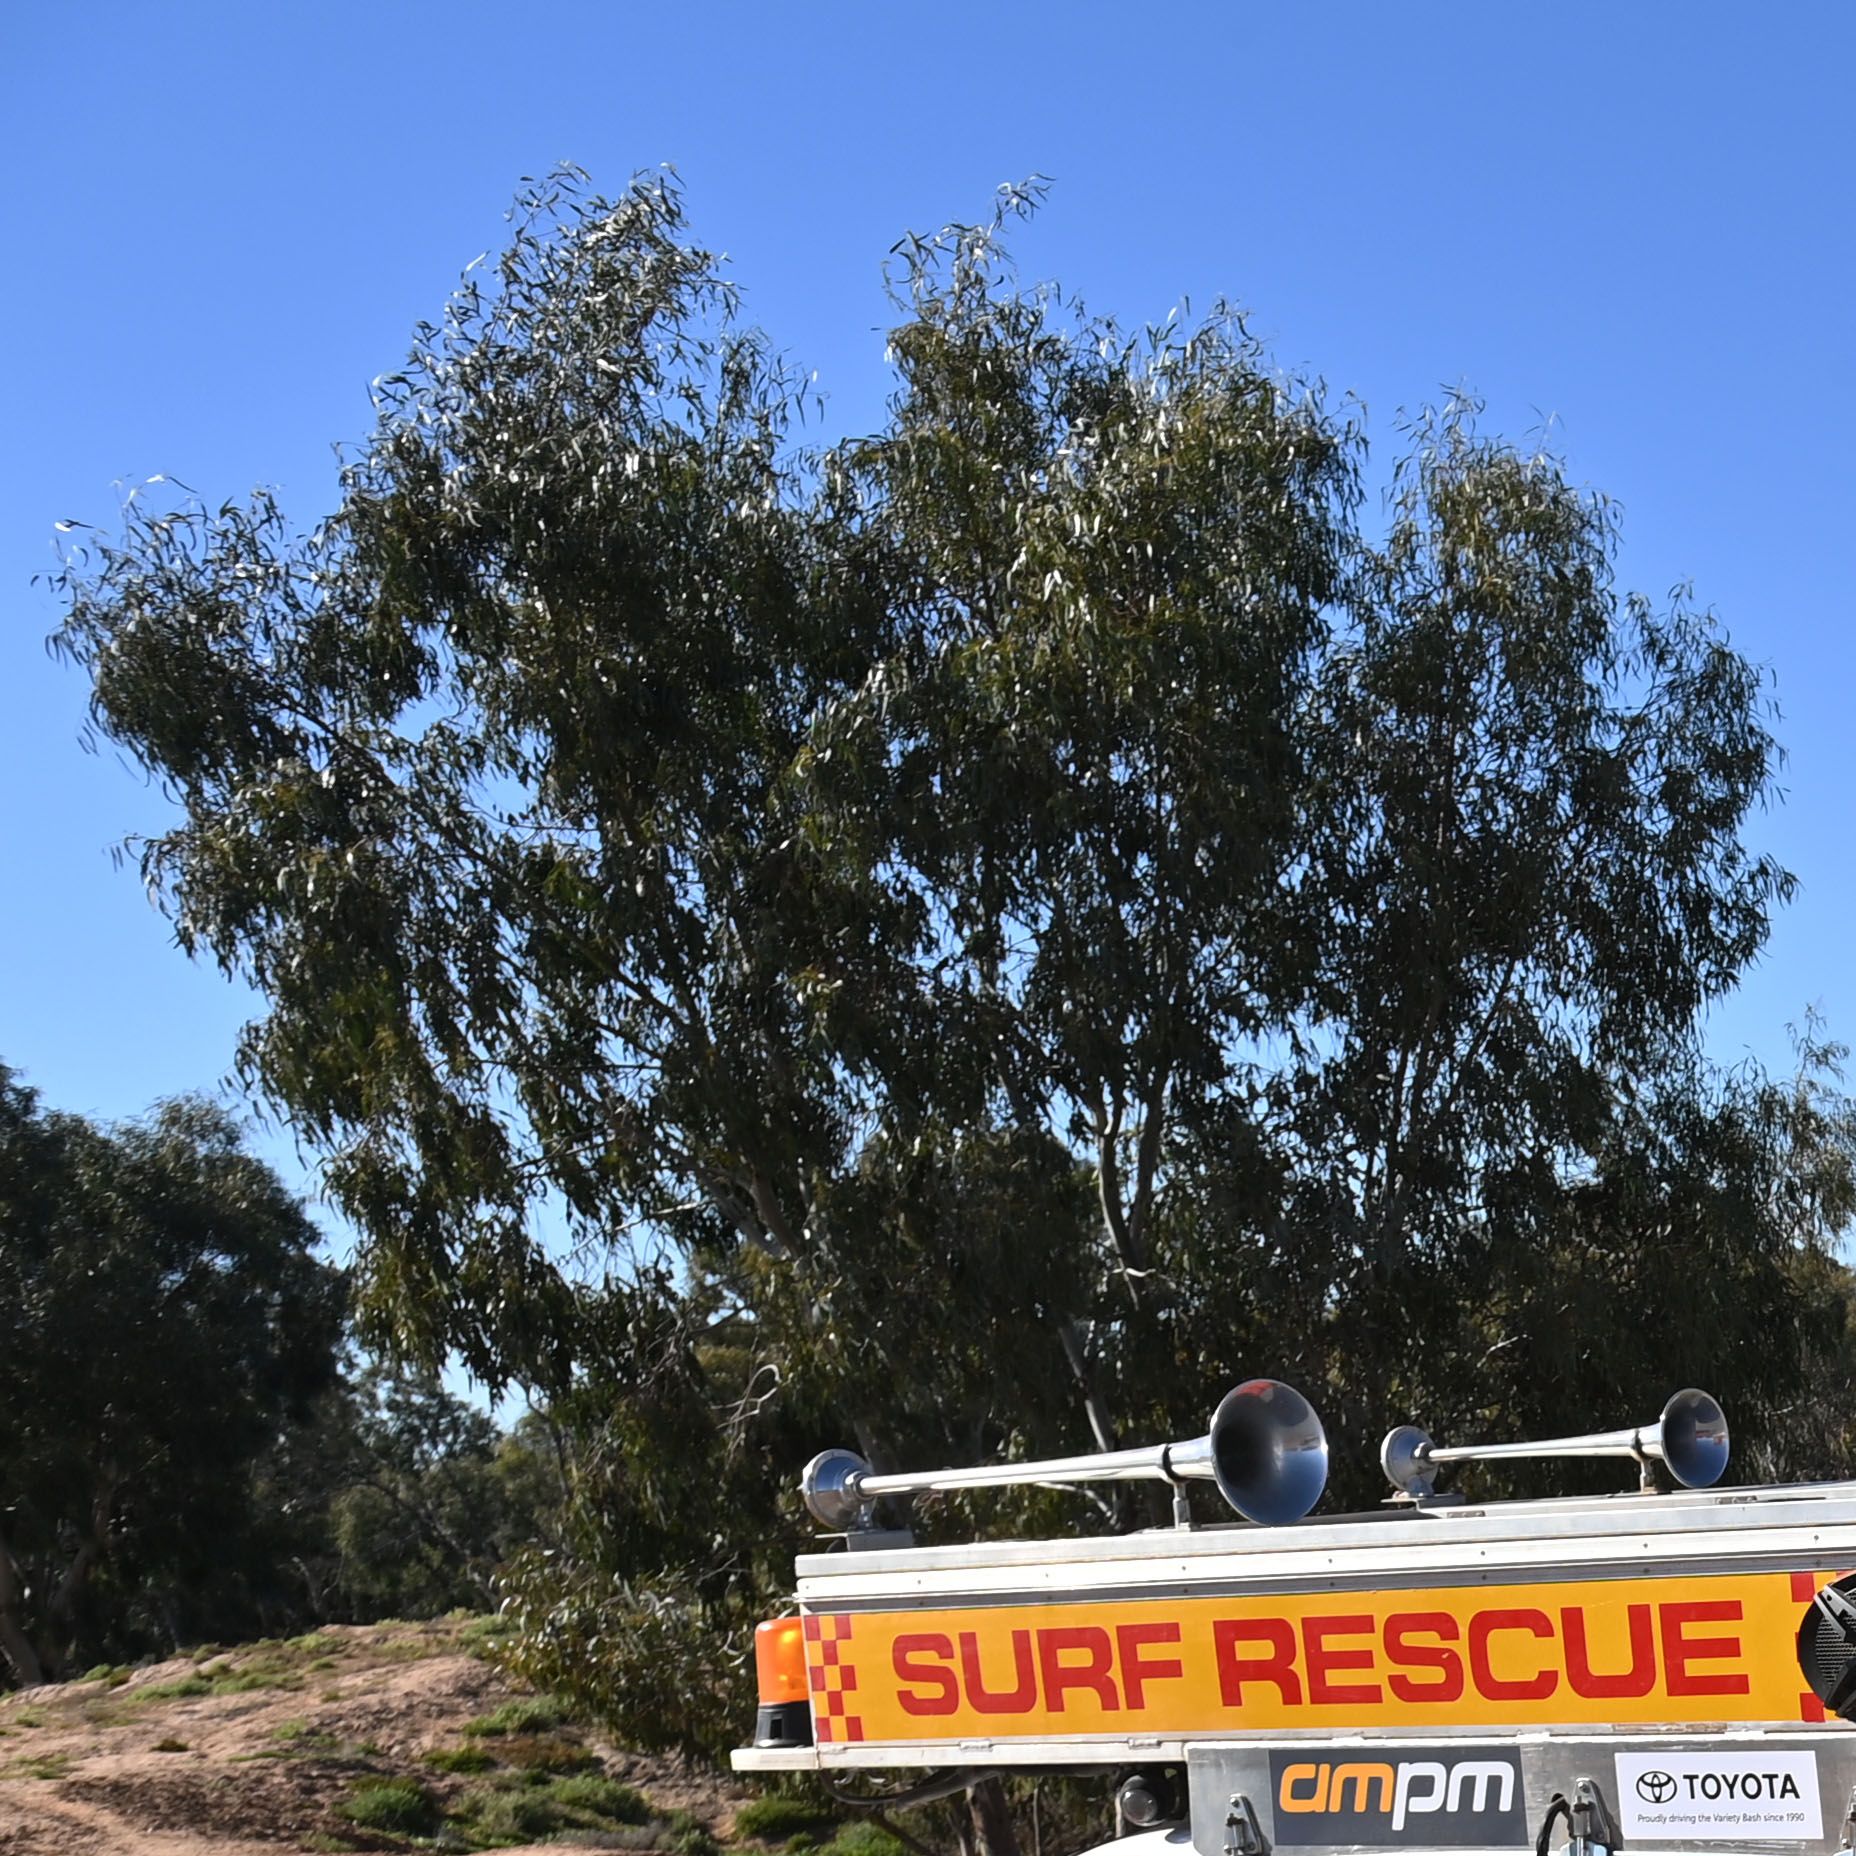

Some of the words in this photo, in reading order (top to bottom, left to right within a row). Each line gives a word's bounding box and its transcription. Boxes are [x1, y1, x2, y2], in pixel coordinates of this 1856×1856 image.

[891, 1622, 1184, 1717] SURF
[1213, 1600, 1750, 1706] RESCUE
[1279, 1761, 1514, 1831] ampm
[1683, 1773, 1801, 1800] TOYOTA
[1637, 1814, 1666, 1824] Proudly
[1669, 1814, 1695, 1824] driving
[1698, 1814, 1711, 1822] the
[1713, 1813, 1741, 1824] Variety
[1742, 1813, 1761, 1822] Bash
[1764, 1813, 1784, 1822] since
[1786, 1813, 1805, 1822] 1990
